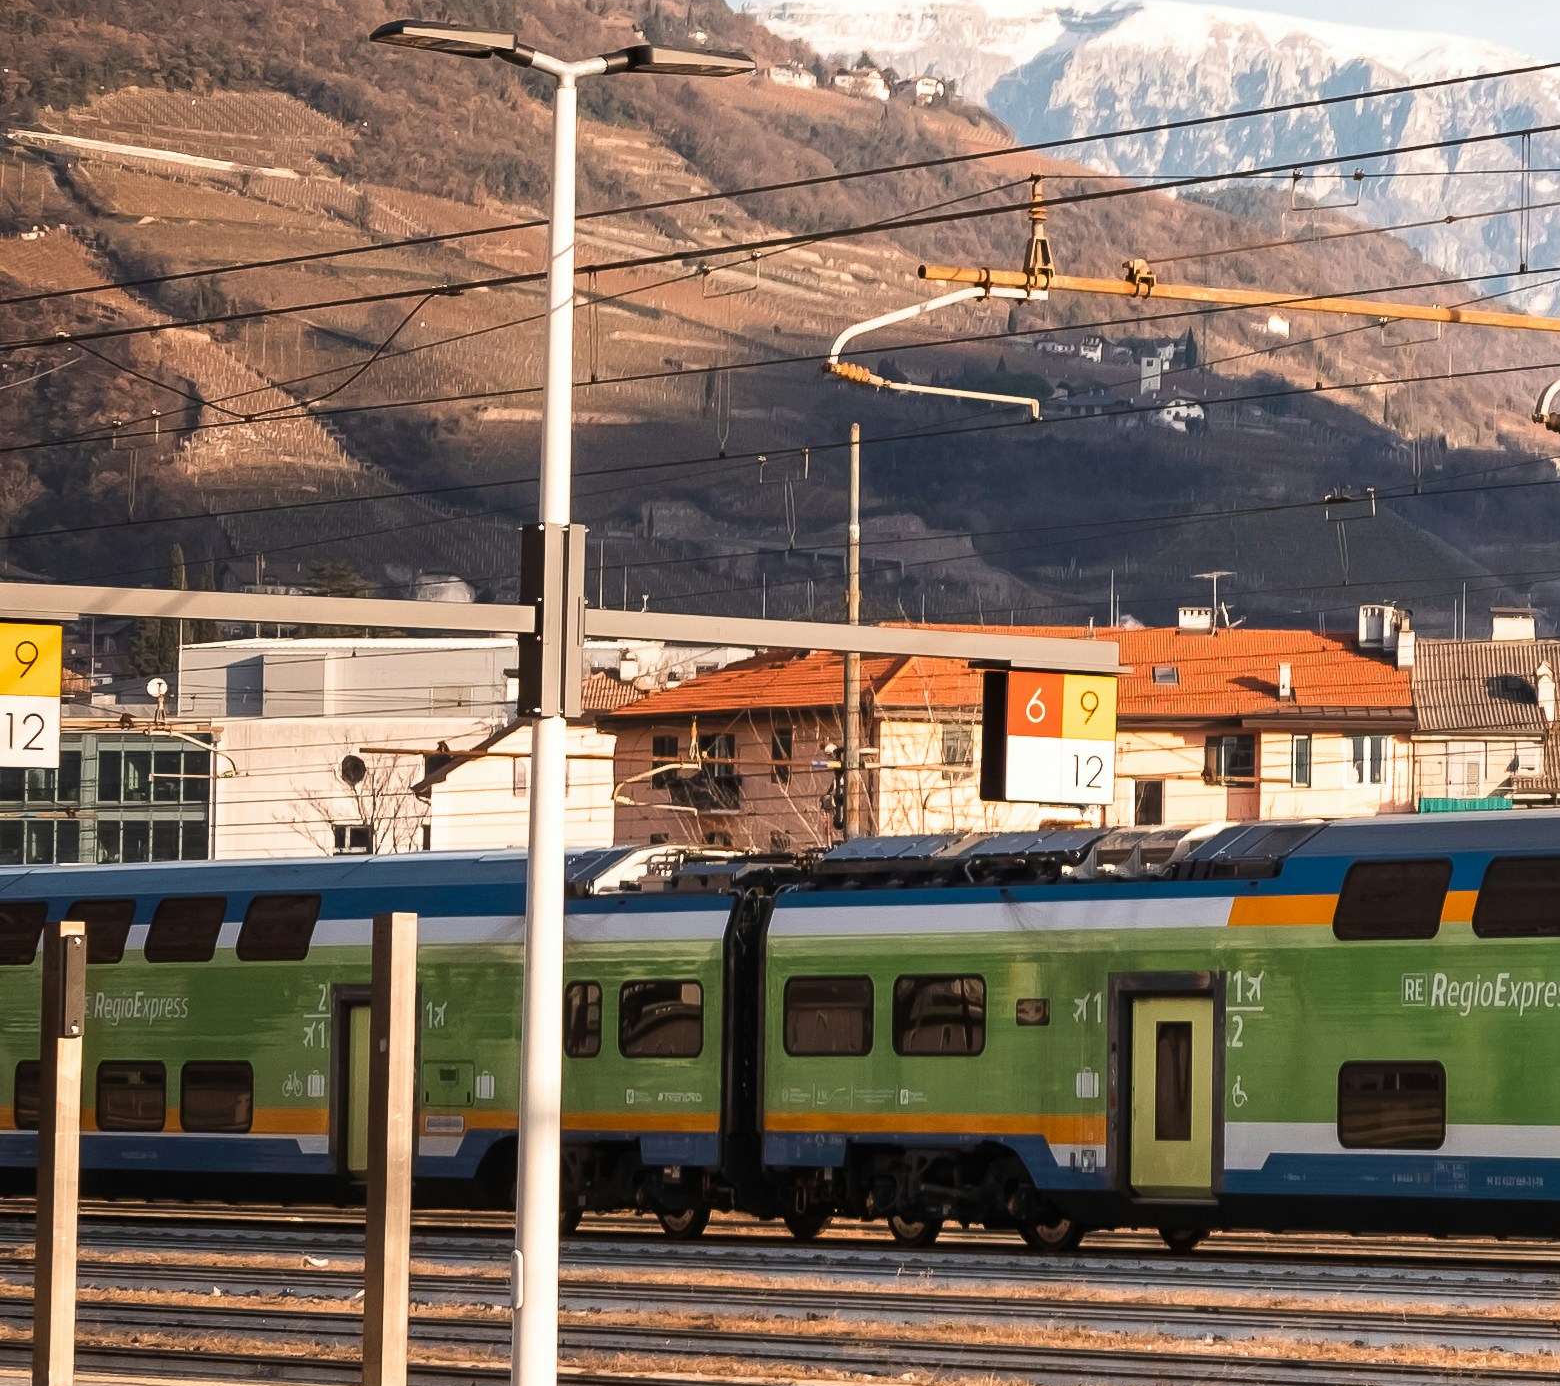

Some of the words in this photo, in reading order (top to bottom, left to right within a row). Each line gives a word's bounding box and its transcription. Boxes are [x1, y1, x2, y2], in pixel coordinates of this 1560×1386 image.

[15, 641, 39, 678] 9
[1025, 688, 1046, 723] 6
[1081, 691, 1099, 725] 9
[5, 713, 45, 750] 12
[1073, 755, 1103, 788] 12
[1404, 978, 1424, 1002] RE
[94, 991, 189, 1025] RegioExpress
